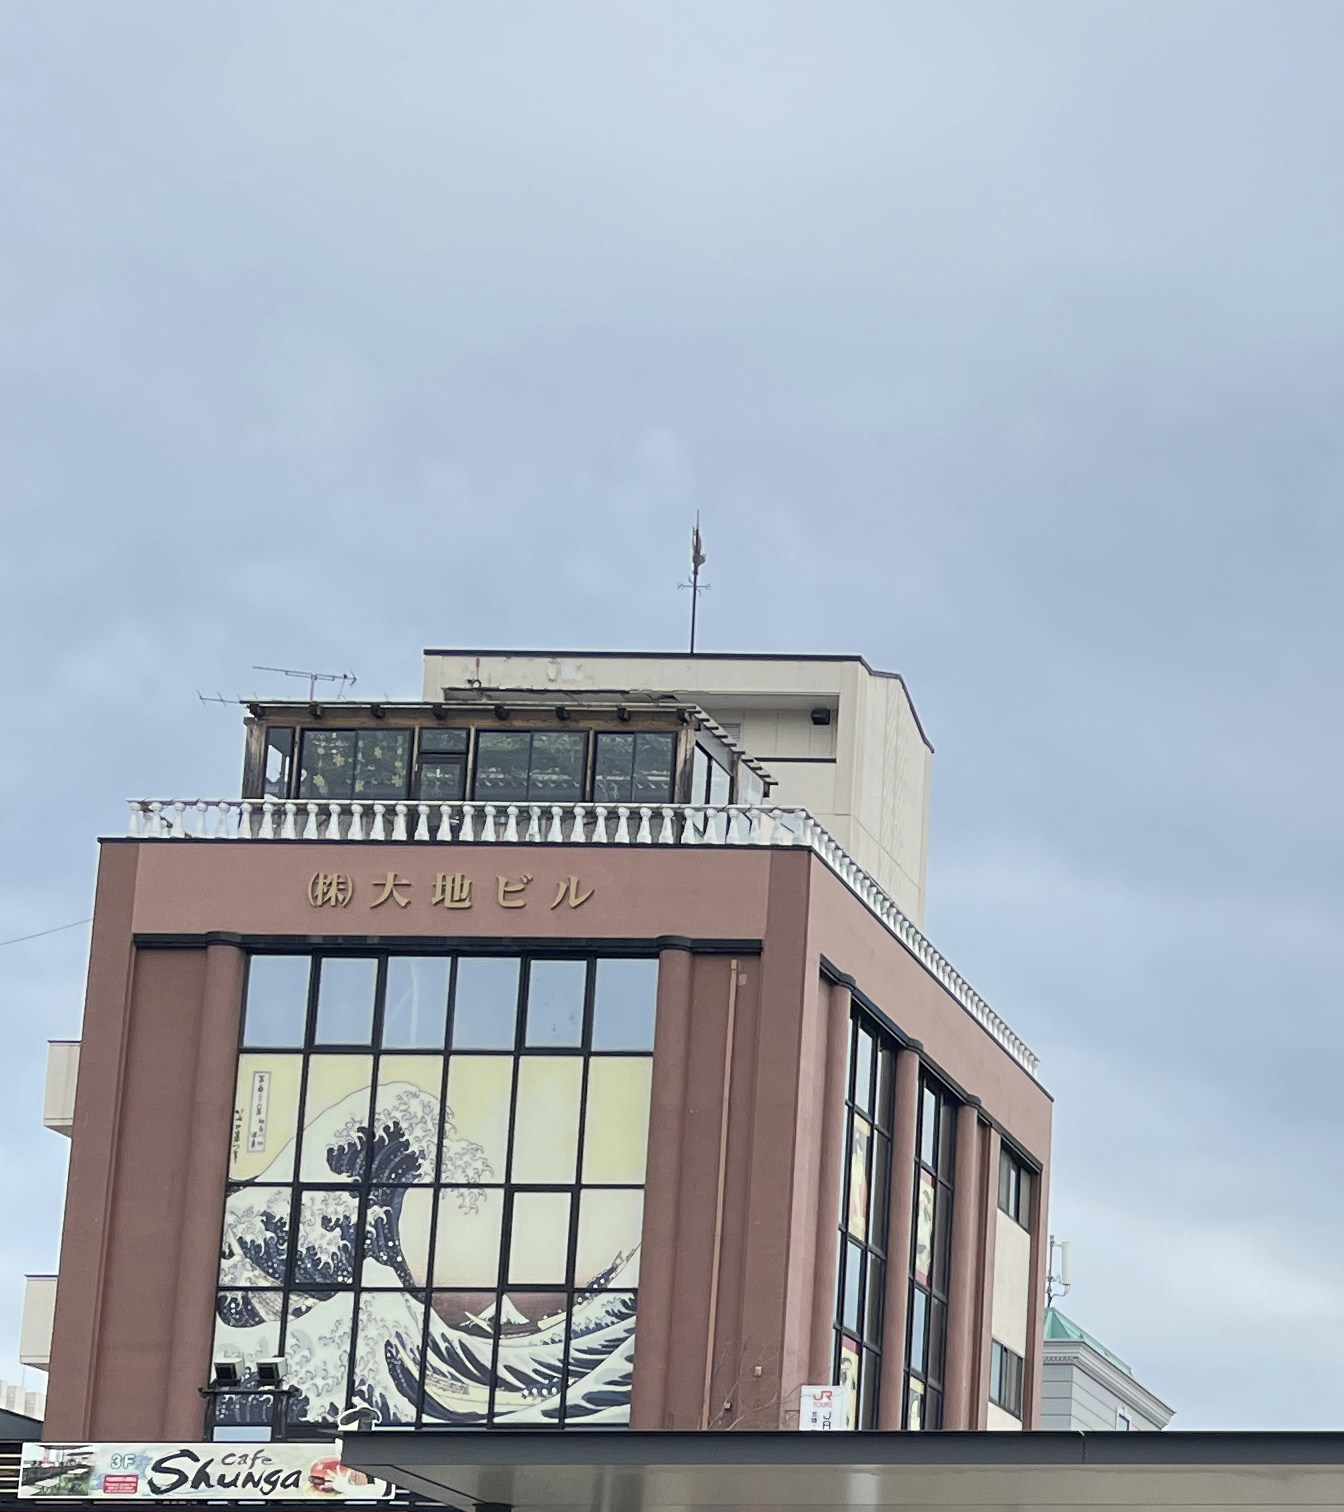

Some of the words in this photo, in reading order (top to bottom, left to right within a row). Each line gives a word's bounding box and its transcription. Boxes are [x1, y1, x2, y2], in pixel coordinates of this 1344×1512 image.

[110, 1453, 137, 1470] 3F
[220, 1449, 274, 1470] cafe
[147, 1449, 303, 1496] Shunga
